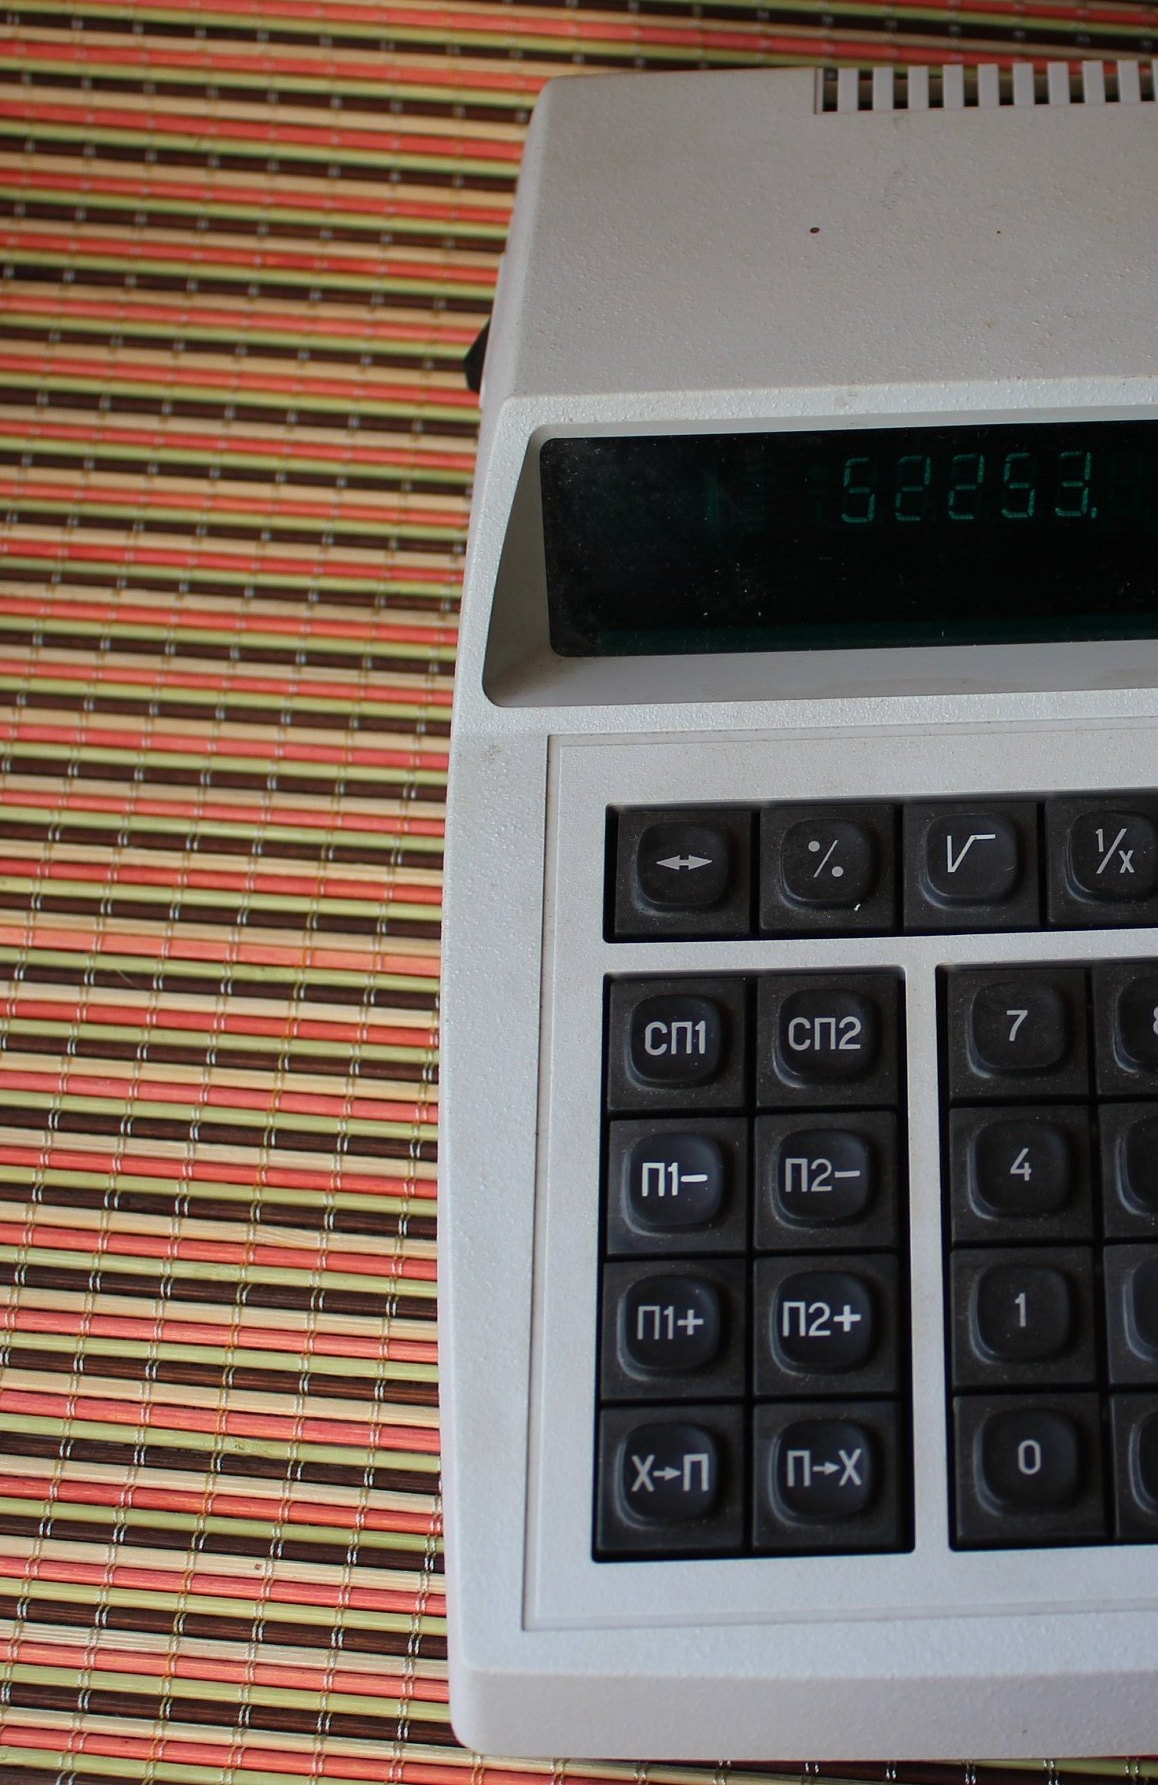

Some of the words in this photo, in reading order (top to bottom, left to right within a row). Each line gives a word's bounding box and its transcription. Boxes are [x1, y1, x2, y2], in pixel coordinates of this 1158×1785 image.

[644, 1020, 706, 1056] СП1
[788, 1016, 862, 1051] СП2
[1006, 1009, 1028, 1042] 7
[1010, 1147, 1032, 1181] 4
[637, 1305, 704, 1340] П1+
[782, 1301, 862, 1337] П2+
[1014, 1292, 1026, 1327] 1
[1018, 1440, 1041, 1475] 0
